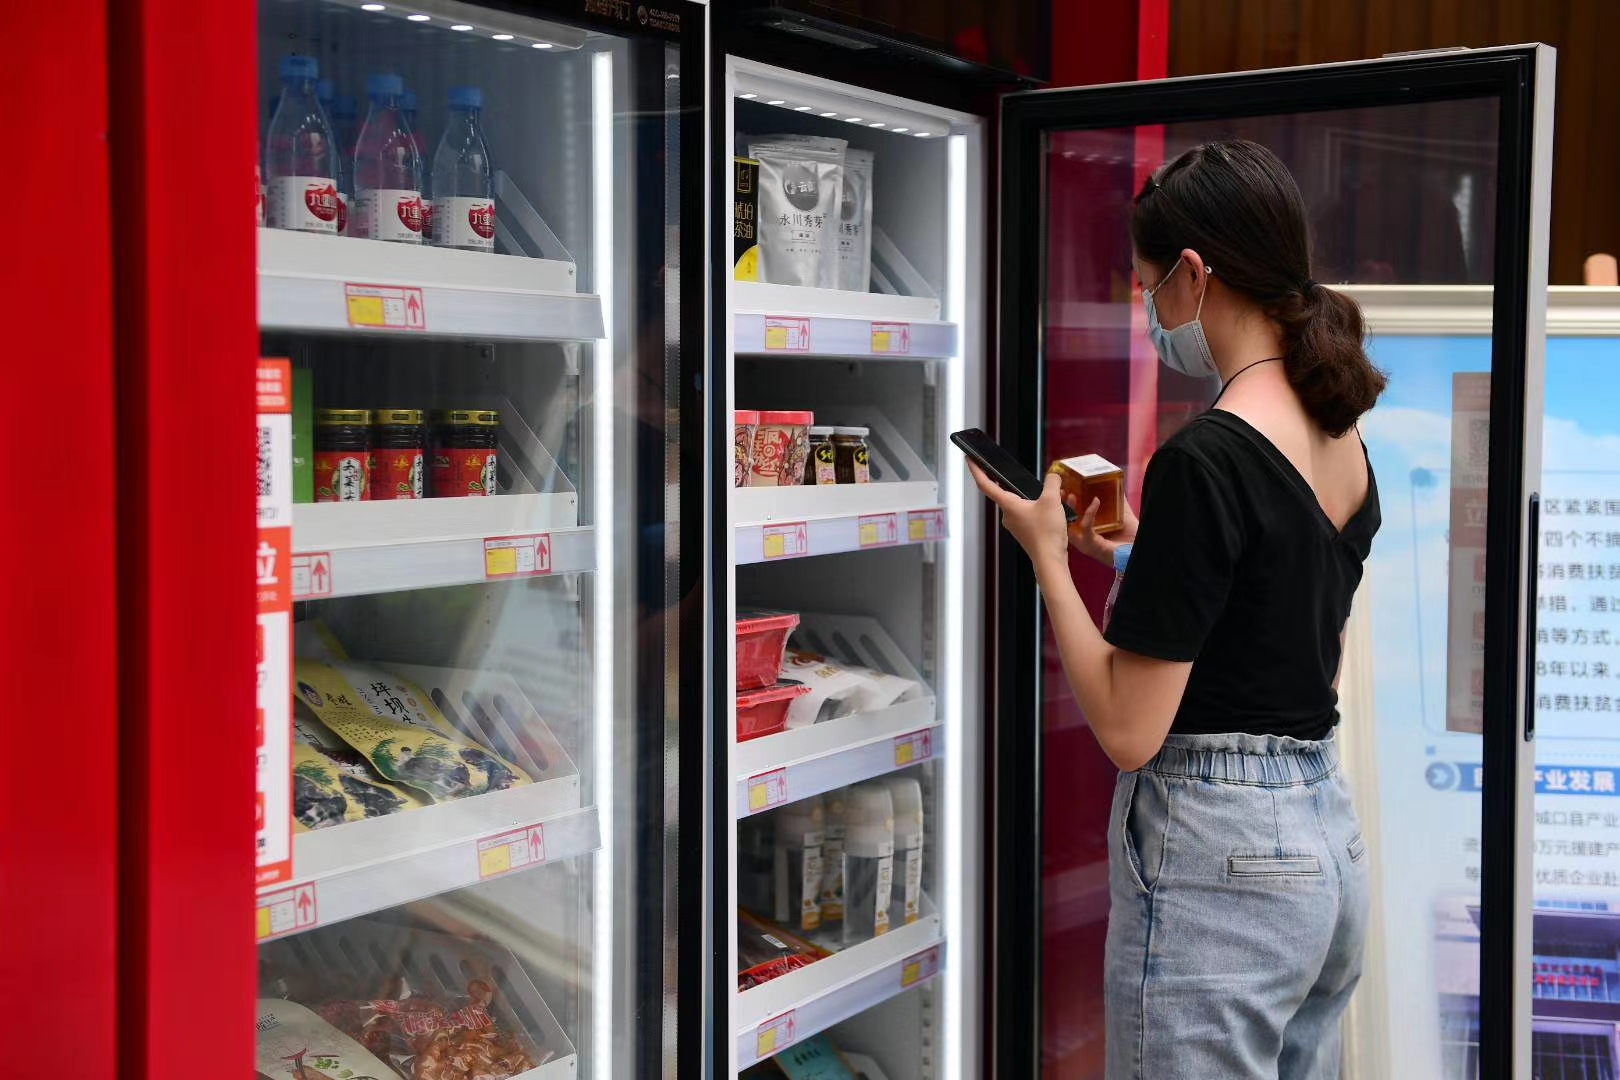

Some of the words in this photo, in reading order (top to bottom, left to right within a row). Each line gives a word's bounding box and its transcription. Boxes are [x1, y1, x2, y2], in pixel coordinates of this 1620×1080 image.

[401, 205, 421, 219] 九重
[1536, 694, 1620, 712] 消费扶贫
